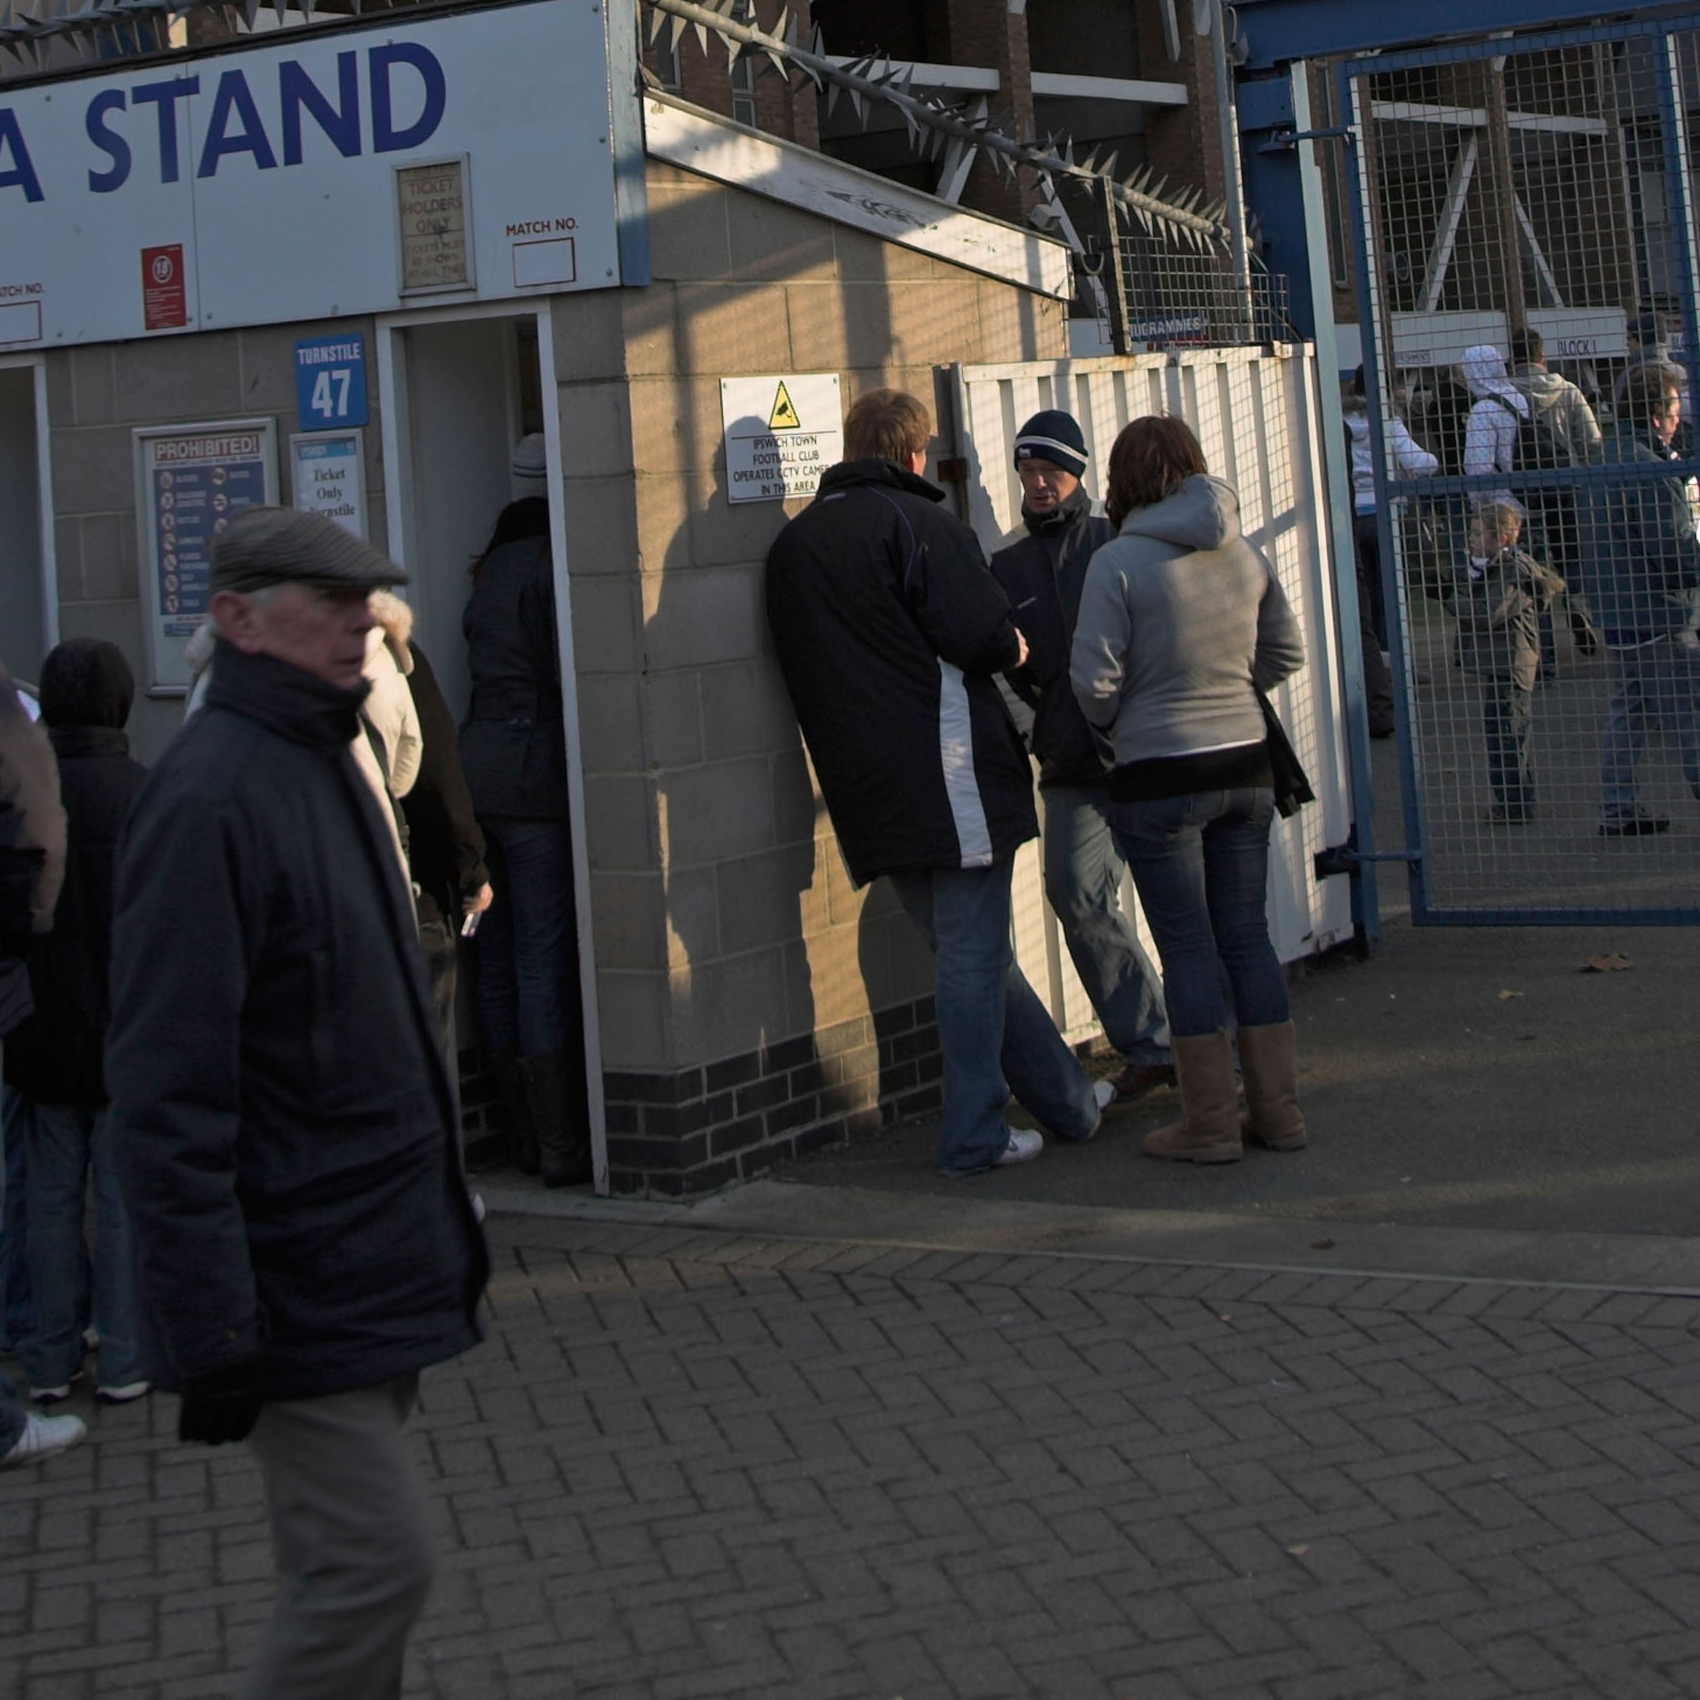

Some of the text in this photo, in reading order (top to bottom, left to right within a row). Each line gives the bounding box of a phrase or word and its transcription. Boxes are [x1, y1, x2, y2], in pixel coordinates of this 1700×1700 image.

[86, 41, 446, 193] STAND
[409, 178, 453, 195] TICKET
[402, 196, 462, 215] HOLDERS
[416, 217, 451, 233] ONLY
[506, 217, 579, 236] MATCH NO.
[297, 342, 361, 365] TURNSTILE
[311, 368, 351, 418] 47
[156, 436, 258, 460] PROHIBITED!
[753, 435, 817, 450] IPSWICH TOWN
[753, 450, 819, 465] FOOTBALL CLUB
[314, 467, 346, 482] Ticket
[733, 469, 774, 482] OPERATES
[777, 467, 799, 478] CCTV
[316, 486, 343, 501] Only
[761, 480, 816, 495] IN THIS AREA
[313, 504, 356, 518] rnstile
